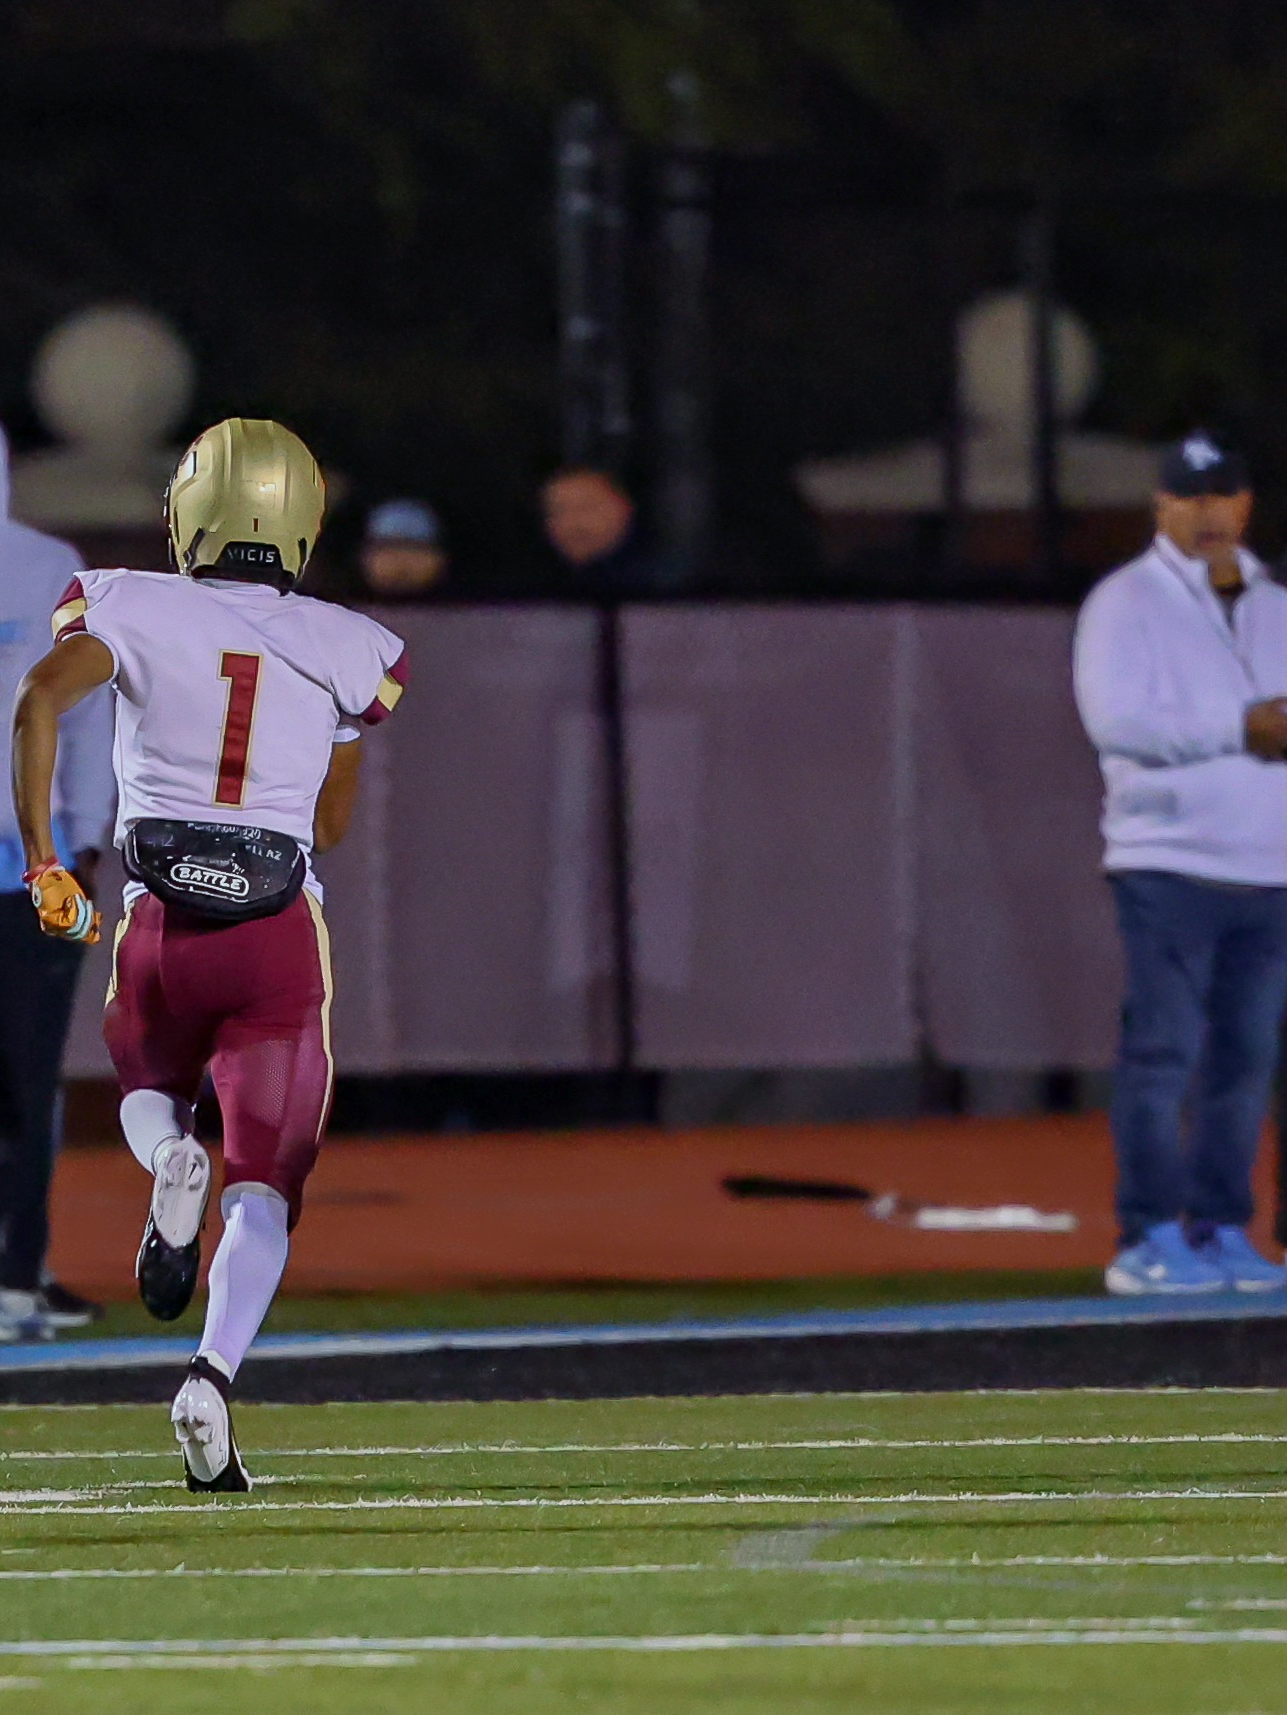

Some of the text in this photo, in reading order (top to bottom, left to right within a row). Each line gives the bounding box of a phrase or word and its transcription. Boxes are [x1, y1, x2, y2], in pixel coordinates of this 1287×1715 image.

[227, 549, 277, 563] VICIS
[212, 649, 263, 810] 1
[179, 867, 243, 890] BATTLE
